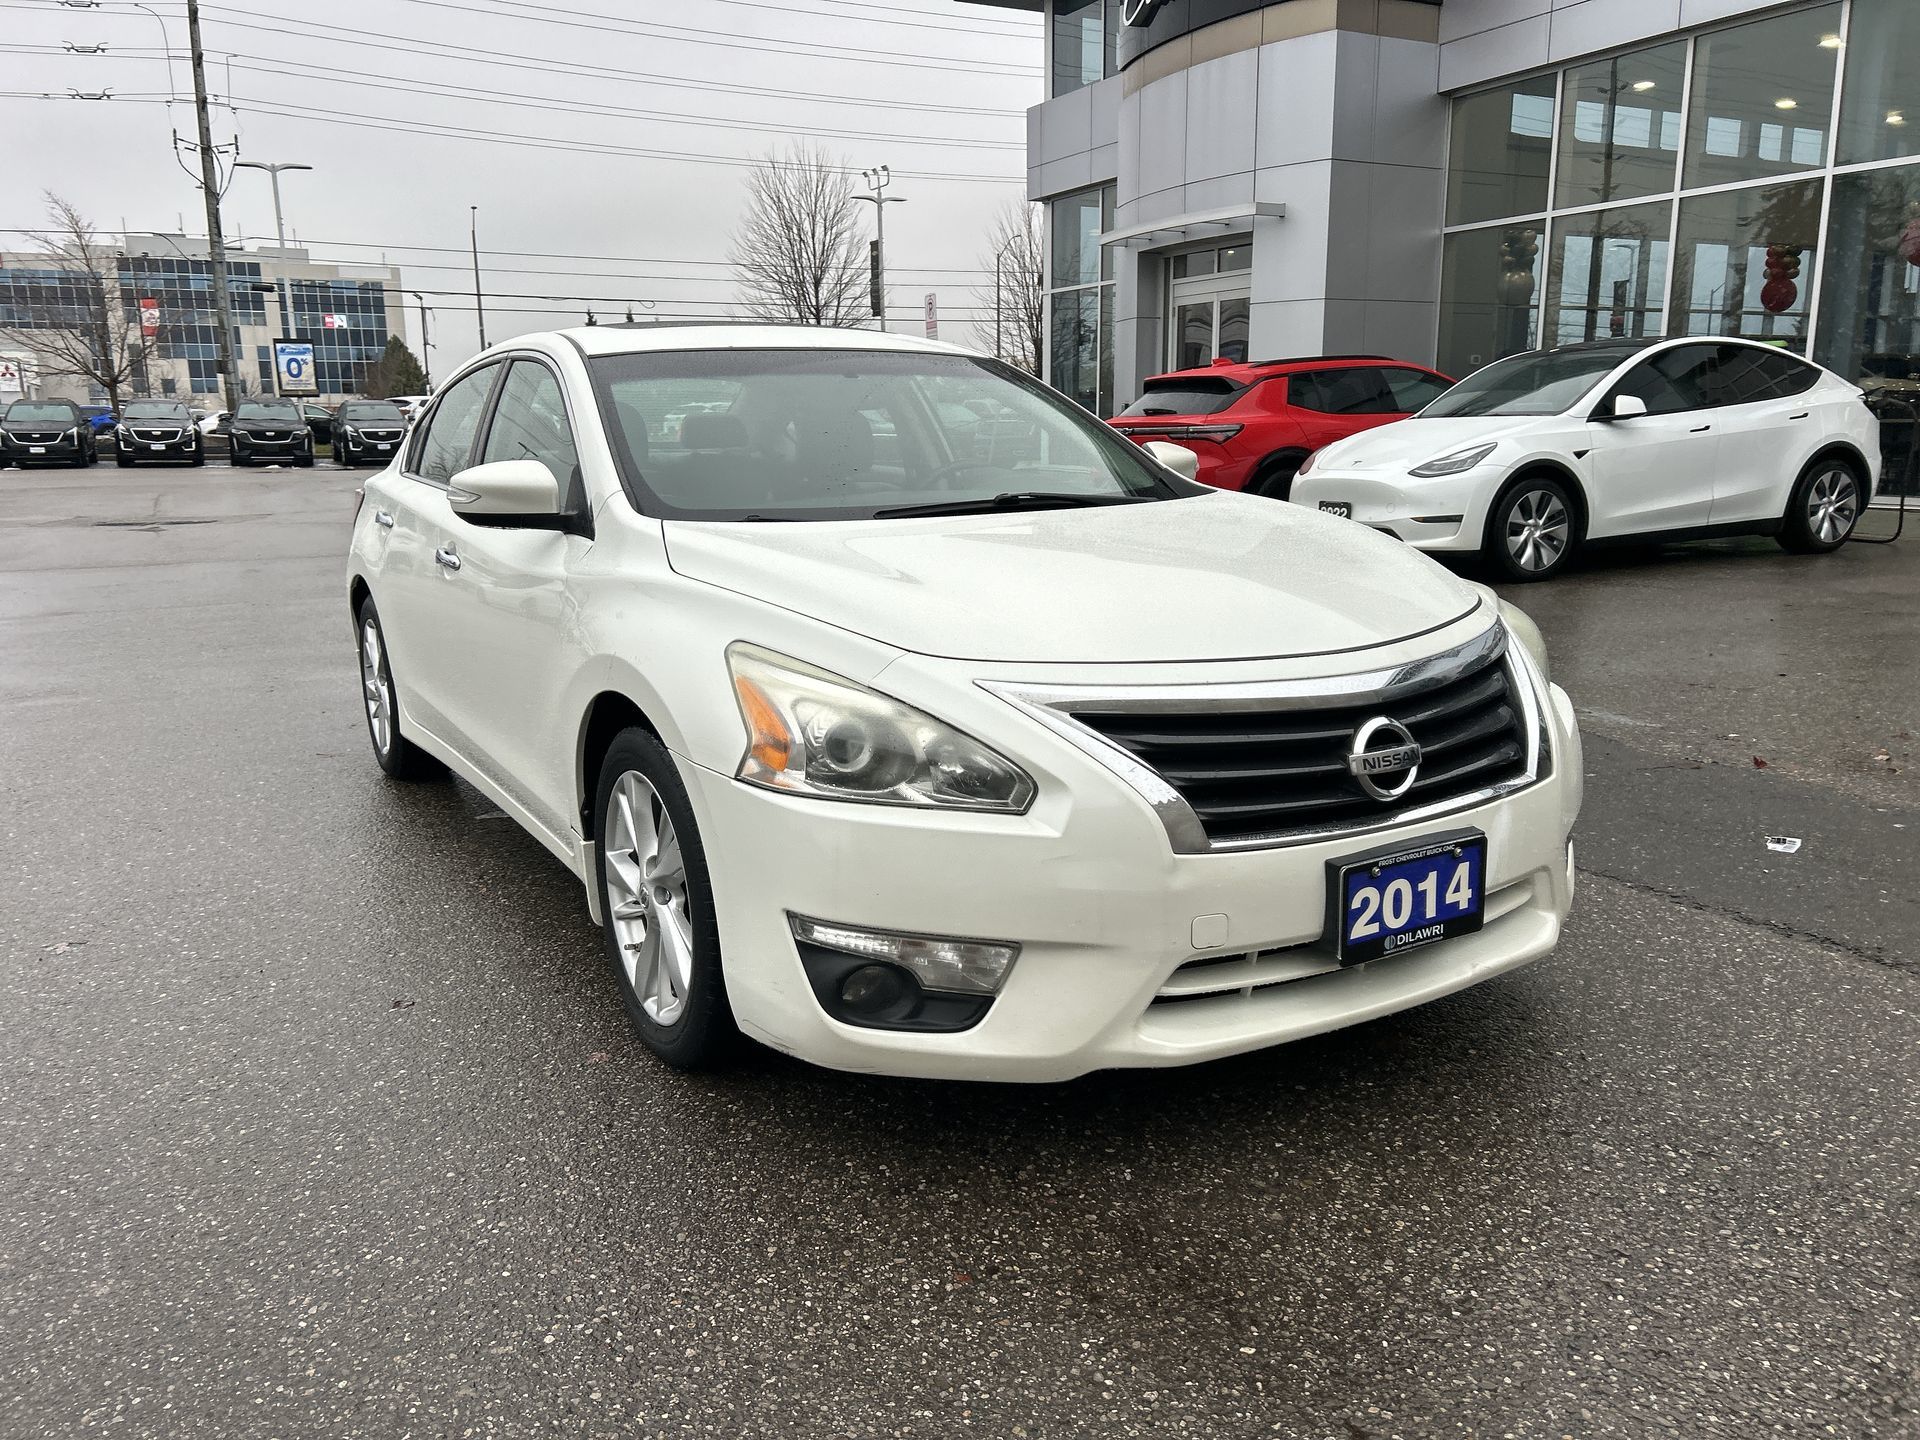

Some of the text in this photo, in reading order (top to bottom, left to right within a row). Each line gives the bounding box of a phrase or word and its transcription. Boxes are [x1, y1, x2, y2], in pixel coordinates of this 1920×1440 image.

[287, 358, 308, 378] 0%
[1362, 748, 1419, 770] NISSAN
[1378, 844, 1455, 867] FROST CHEVROLET BUICK GMC
[1350, 861, 1472, 939] 2014
[1396, 923, 1444, 945] DILAWRI
